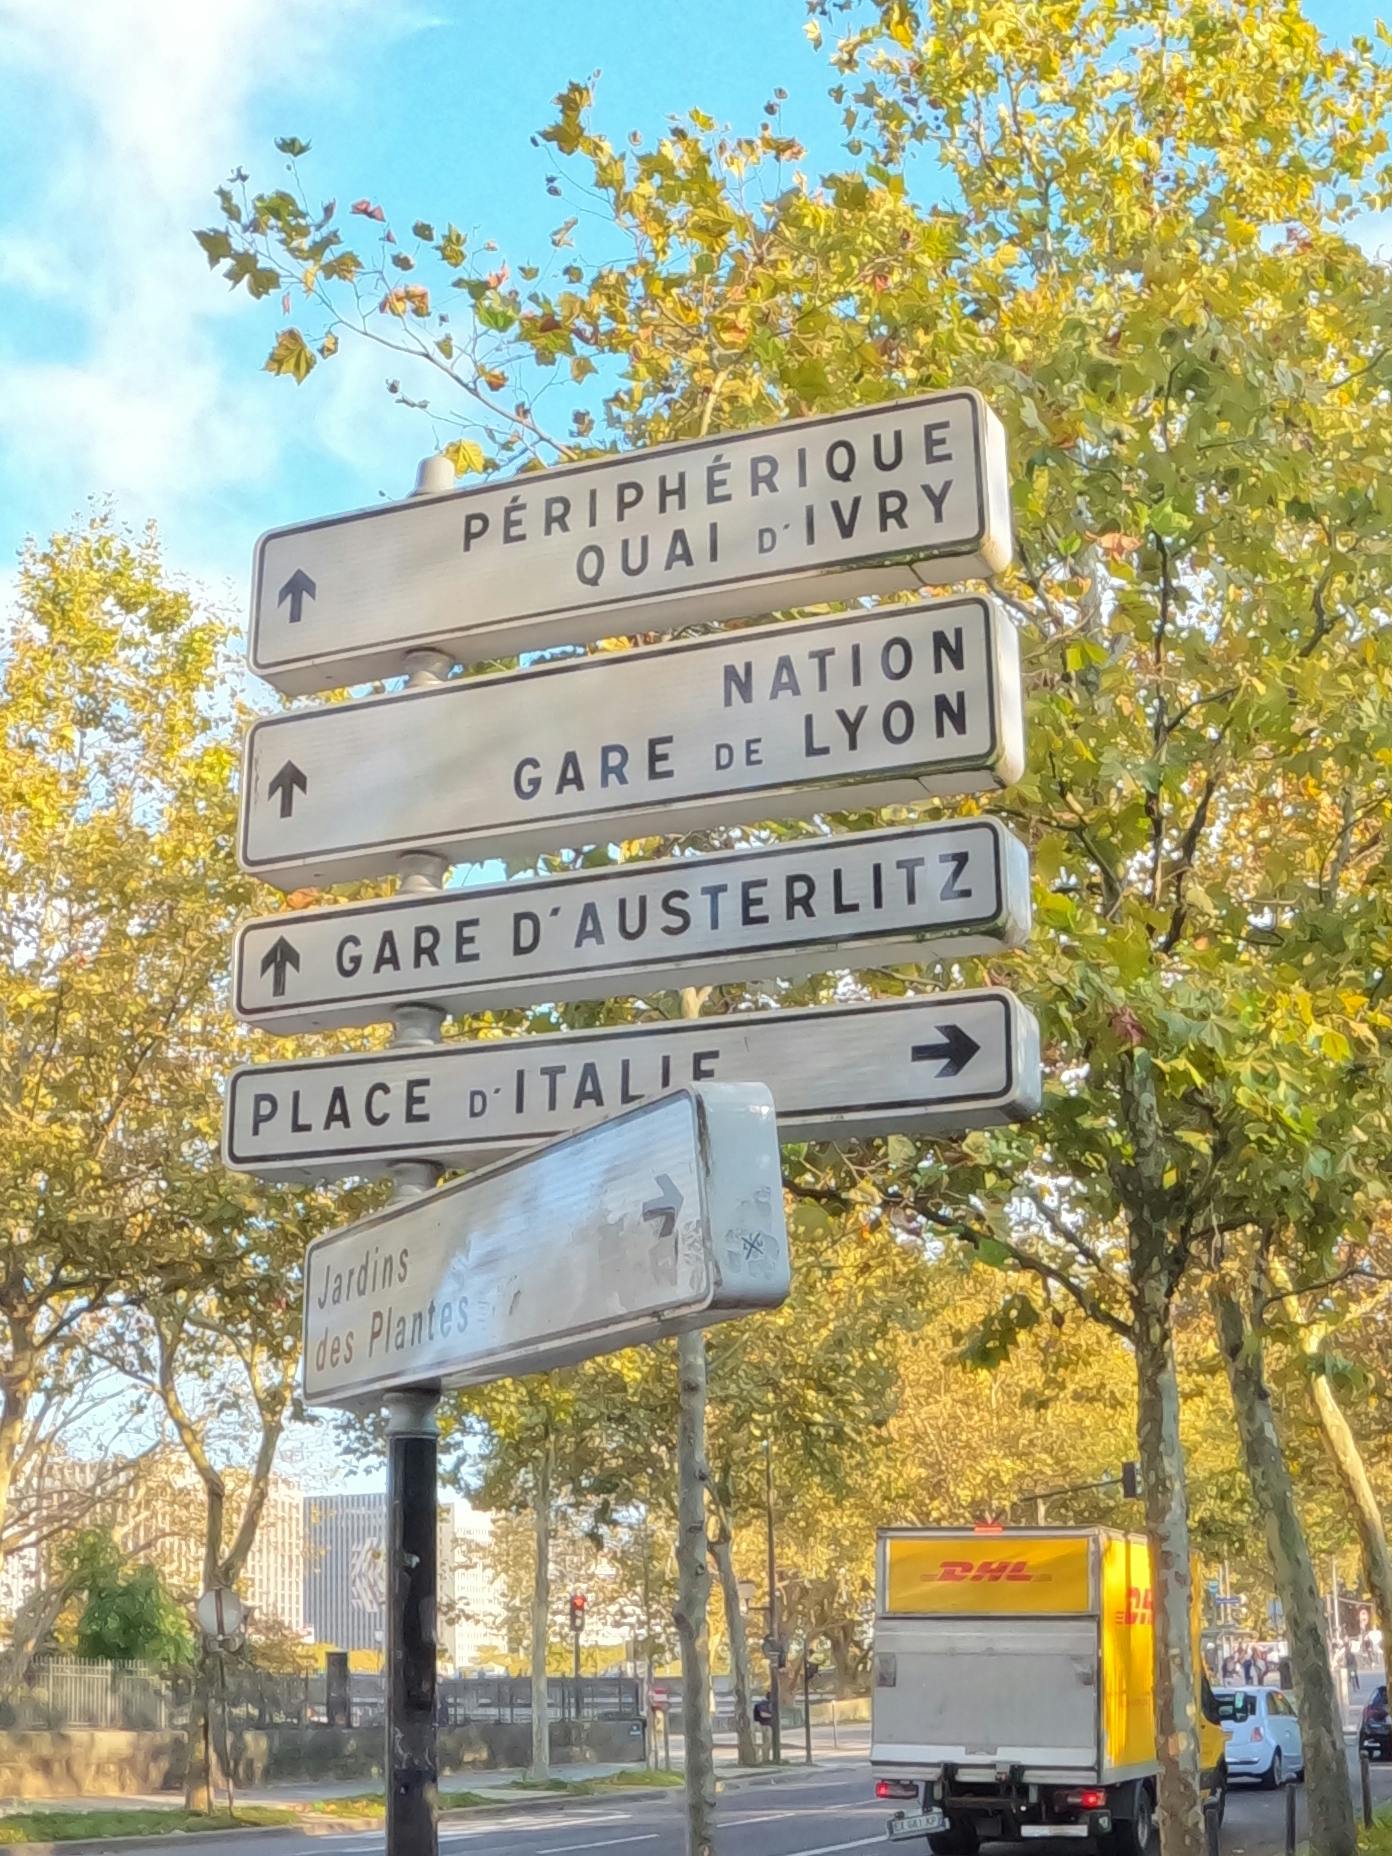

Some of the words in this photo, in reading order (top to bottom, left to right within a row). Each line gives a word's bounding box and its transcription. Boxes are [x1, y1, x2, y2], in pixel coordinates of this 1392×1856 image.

[463, 420, 953, 552] PÉRIPHÉRIQUE
[576, 521, 717, 586] QUAI
[758, 479, 953, 556] D'IVRY
[723, 627, 965, 707] NATION
[514, 735, 673, 800] GARE
[715, 738, 763, 771] DE
[805, 691, 967, 758] LYON
[336, 918, 480, 977] GARE
[513, 851, 973, 957] D'AUSTERLITZ
[252, 1078, 430, 1137] PLACE
[317, 1247, 408, 1309] Jardins
[316, 1329, 354, 1372] des
[368, 1295, 468, 1358] Plantes
[937, 1561, 1033, 1582] DHL
[1125, 1587, 1152, 1625] DH
